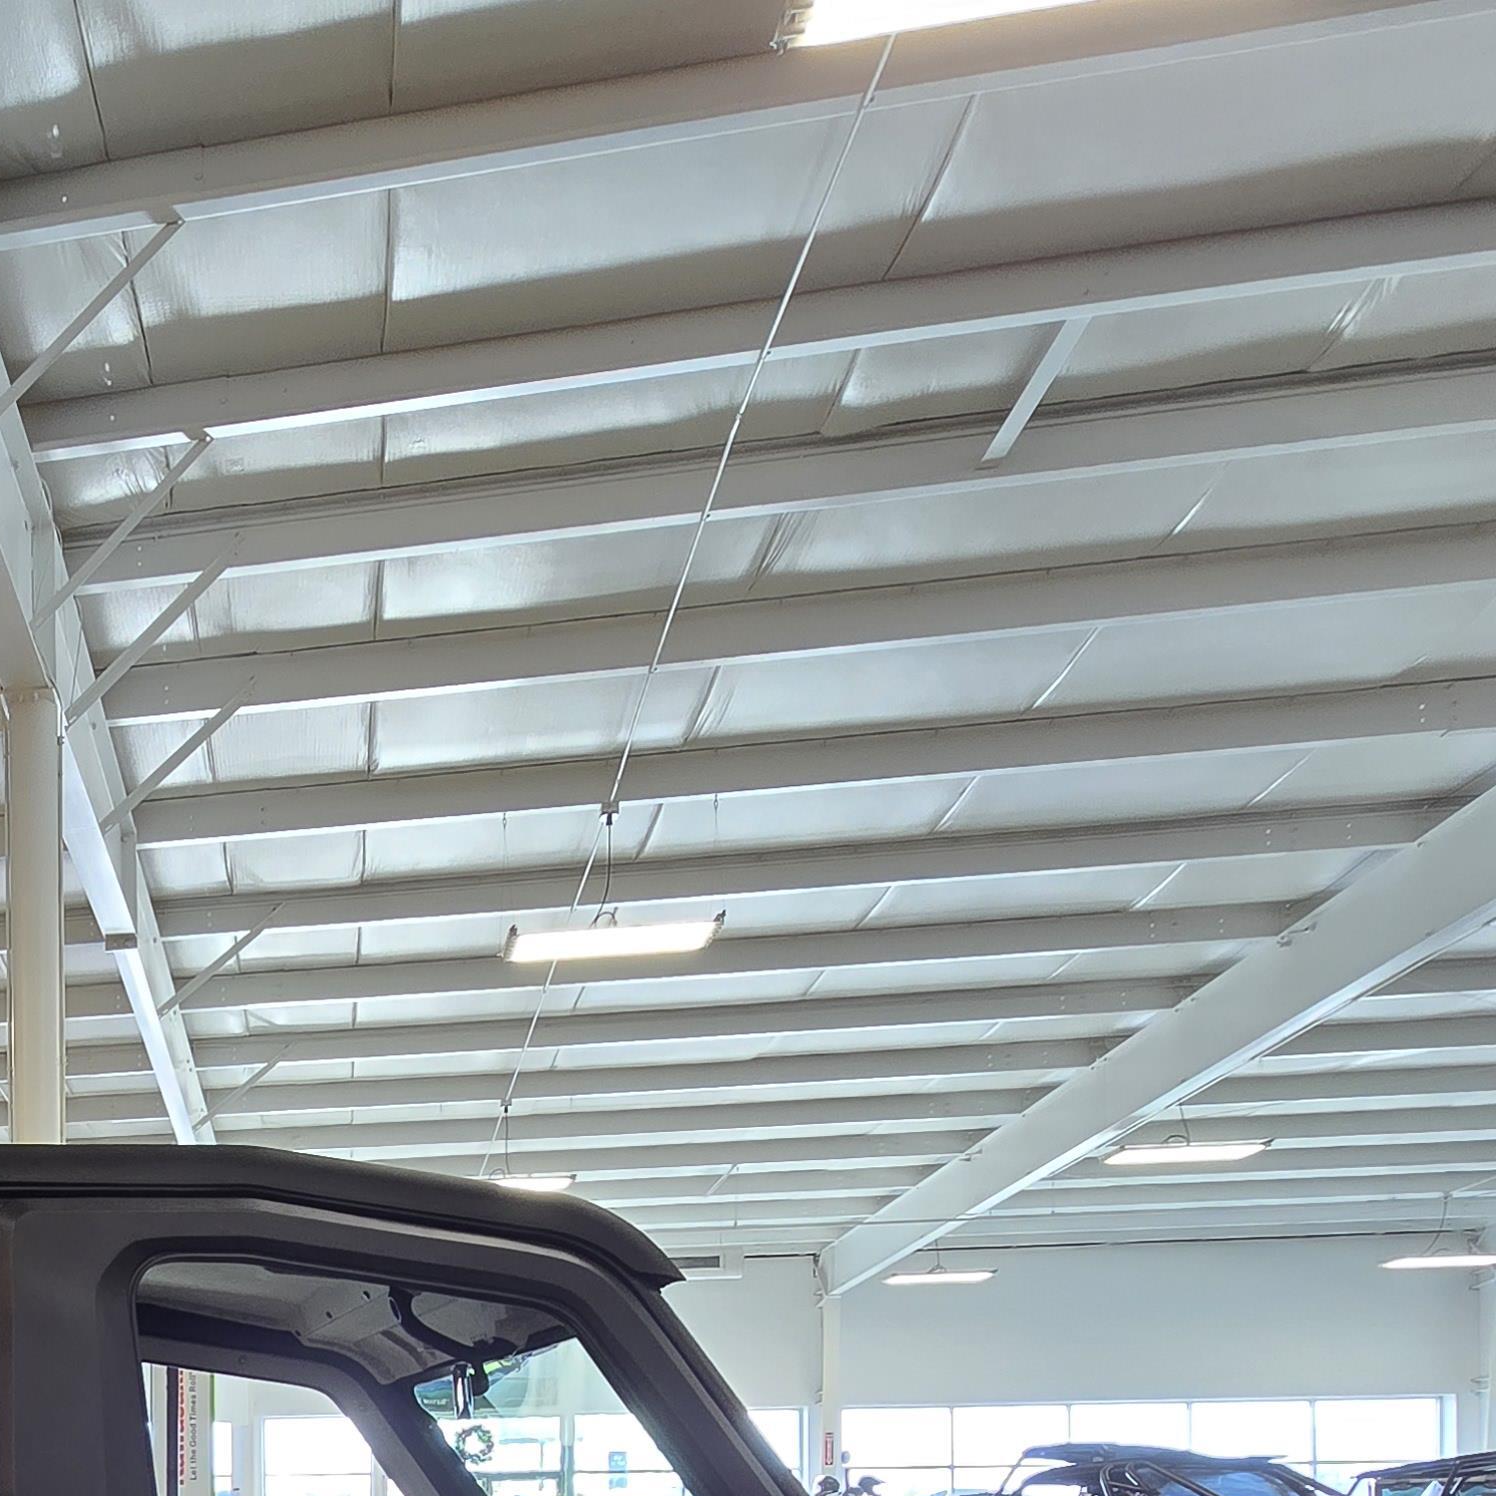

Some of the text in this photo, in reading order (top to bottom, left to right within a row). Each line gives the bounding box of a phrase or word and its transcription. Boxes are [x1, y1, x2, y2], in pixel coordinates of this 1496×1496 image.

[189, 1423, 197, 1448] Good
[189, 1449, 197, 1464] the
[189, 1466, 197, 1481] Let
